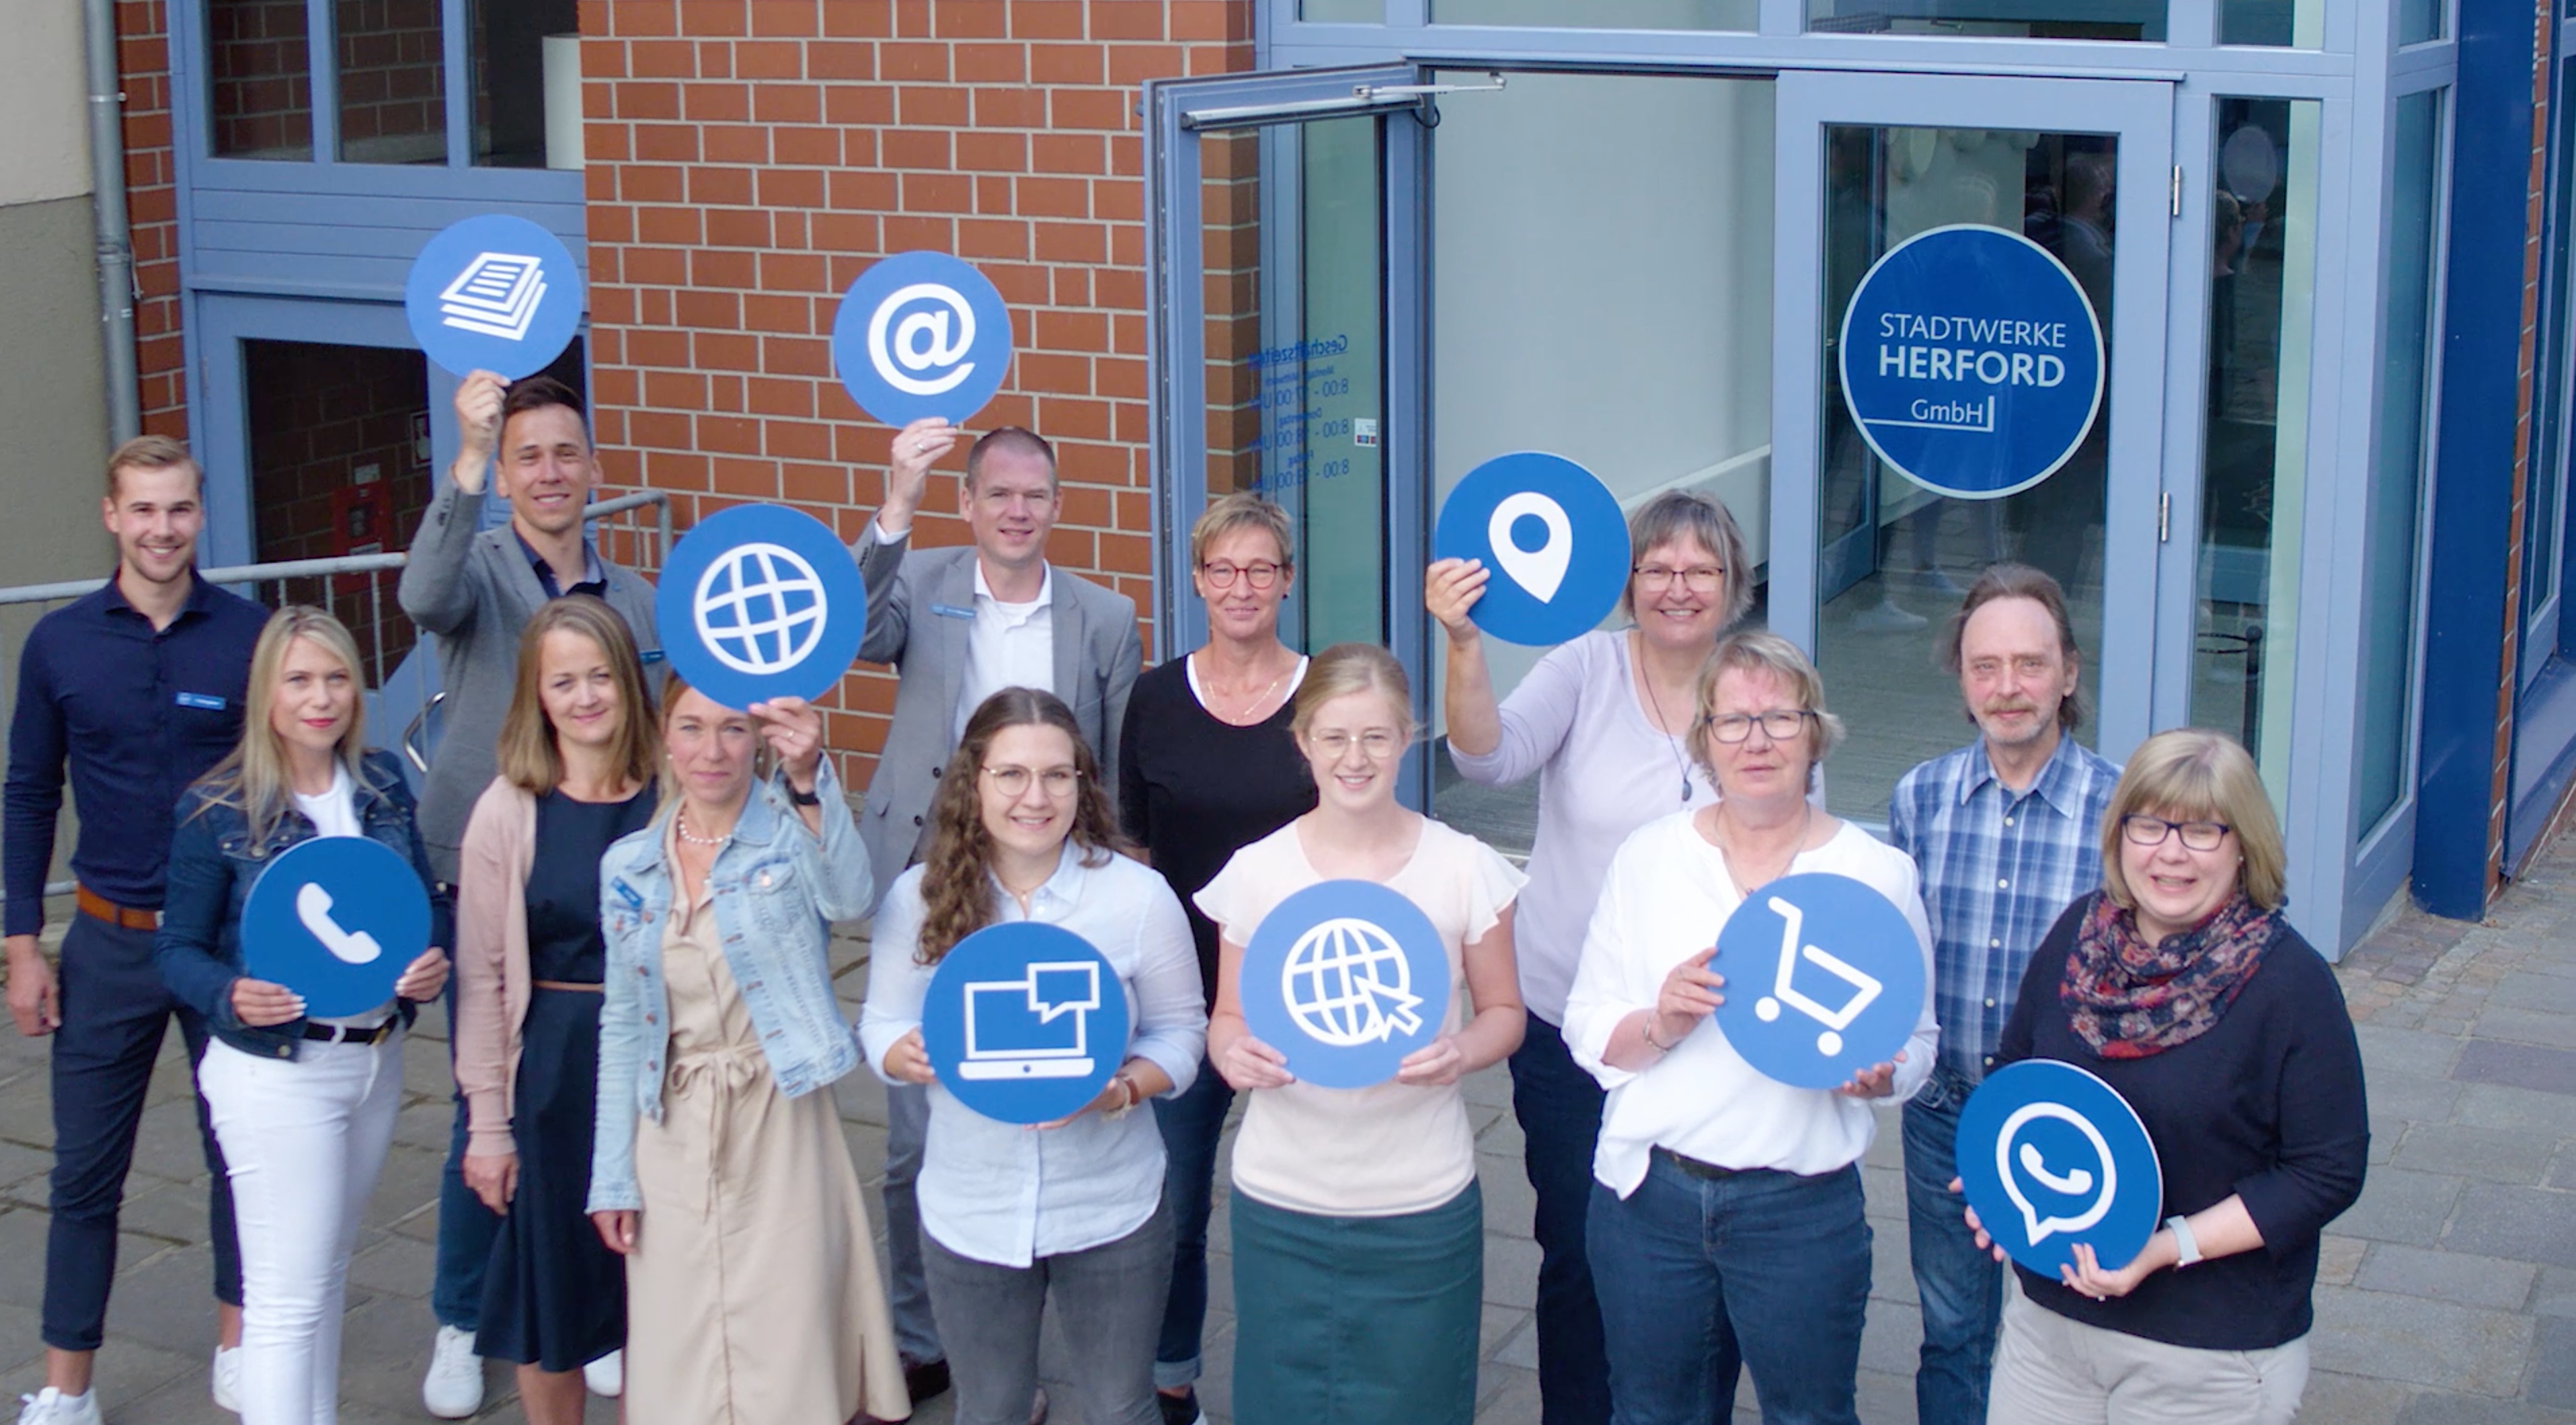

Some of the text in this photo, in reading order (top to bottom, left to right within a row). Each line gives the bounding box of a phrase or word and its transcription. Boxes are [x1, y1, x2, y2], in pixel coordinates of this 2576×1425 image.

[1880, 312, 2066, 348] STADTWERKE
[1879, 344, 2066, 388] HERFORD
[1911, 399, 1984, 424] GmbH
